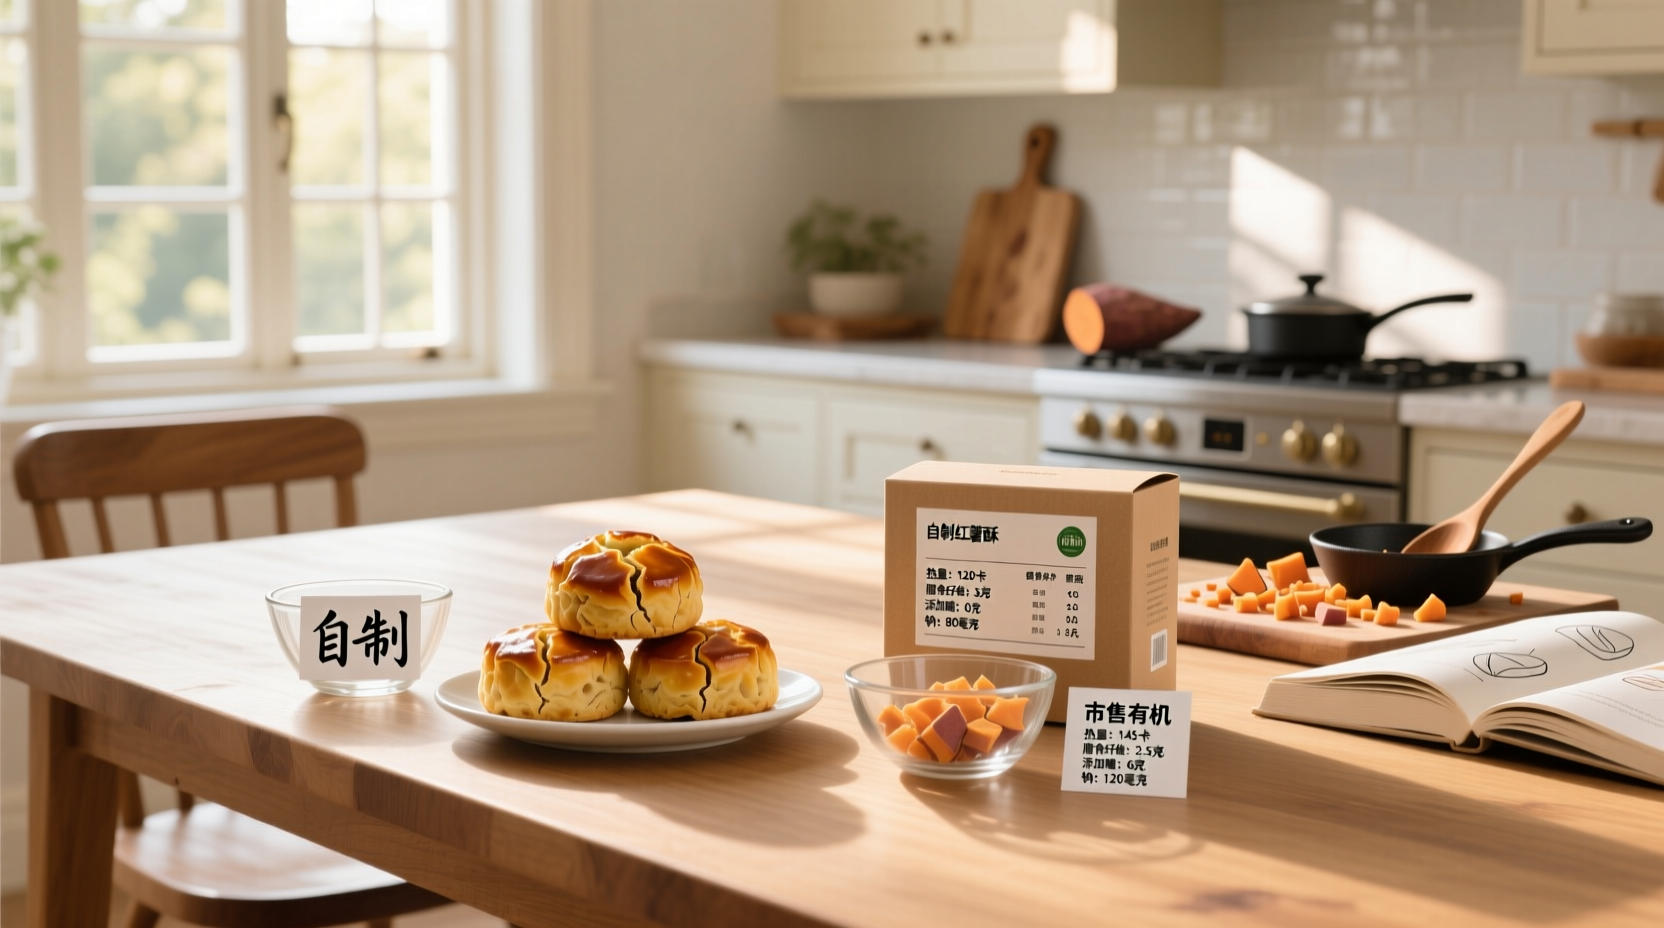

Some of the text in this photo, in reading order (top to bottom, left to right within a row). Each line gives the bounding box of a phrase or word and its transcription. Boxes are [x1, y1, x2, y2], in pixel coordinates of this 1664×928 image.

[312, 609, 408, 667] 自制
[1084, 701, 1172, 726] 市售有机
